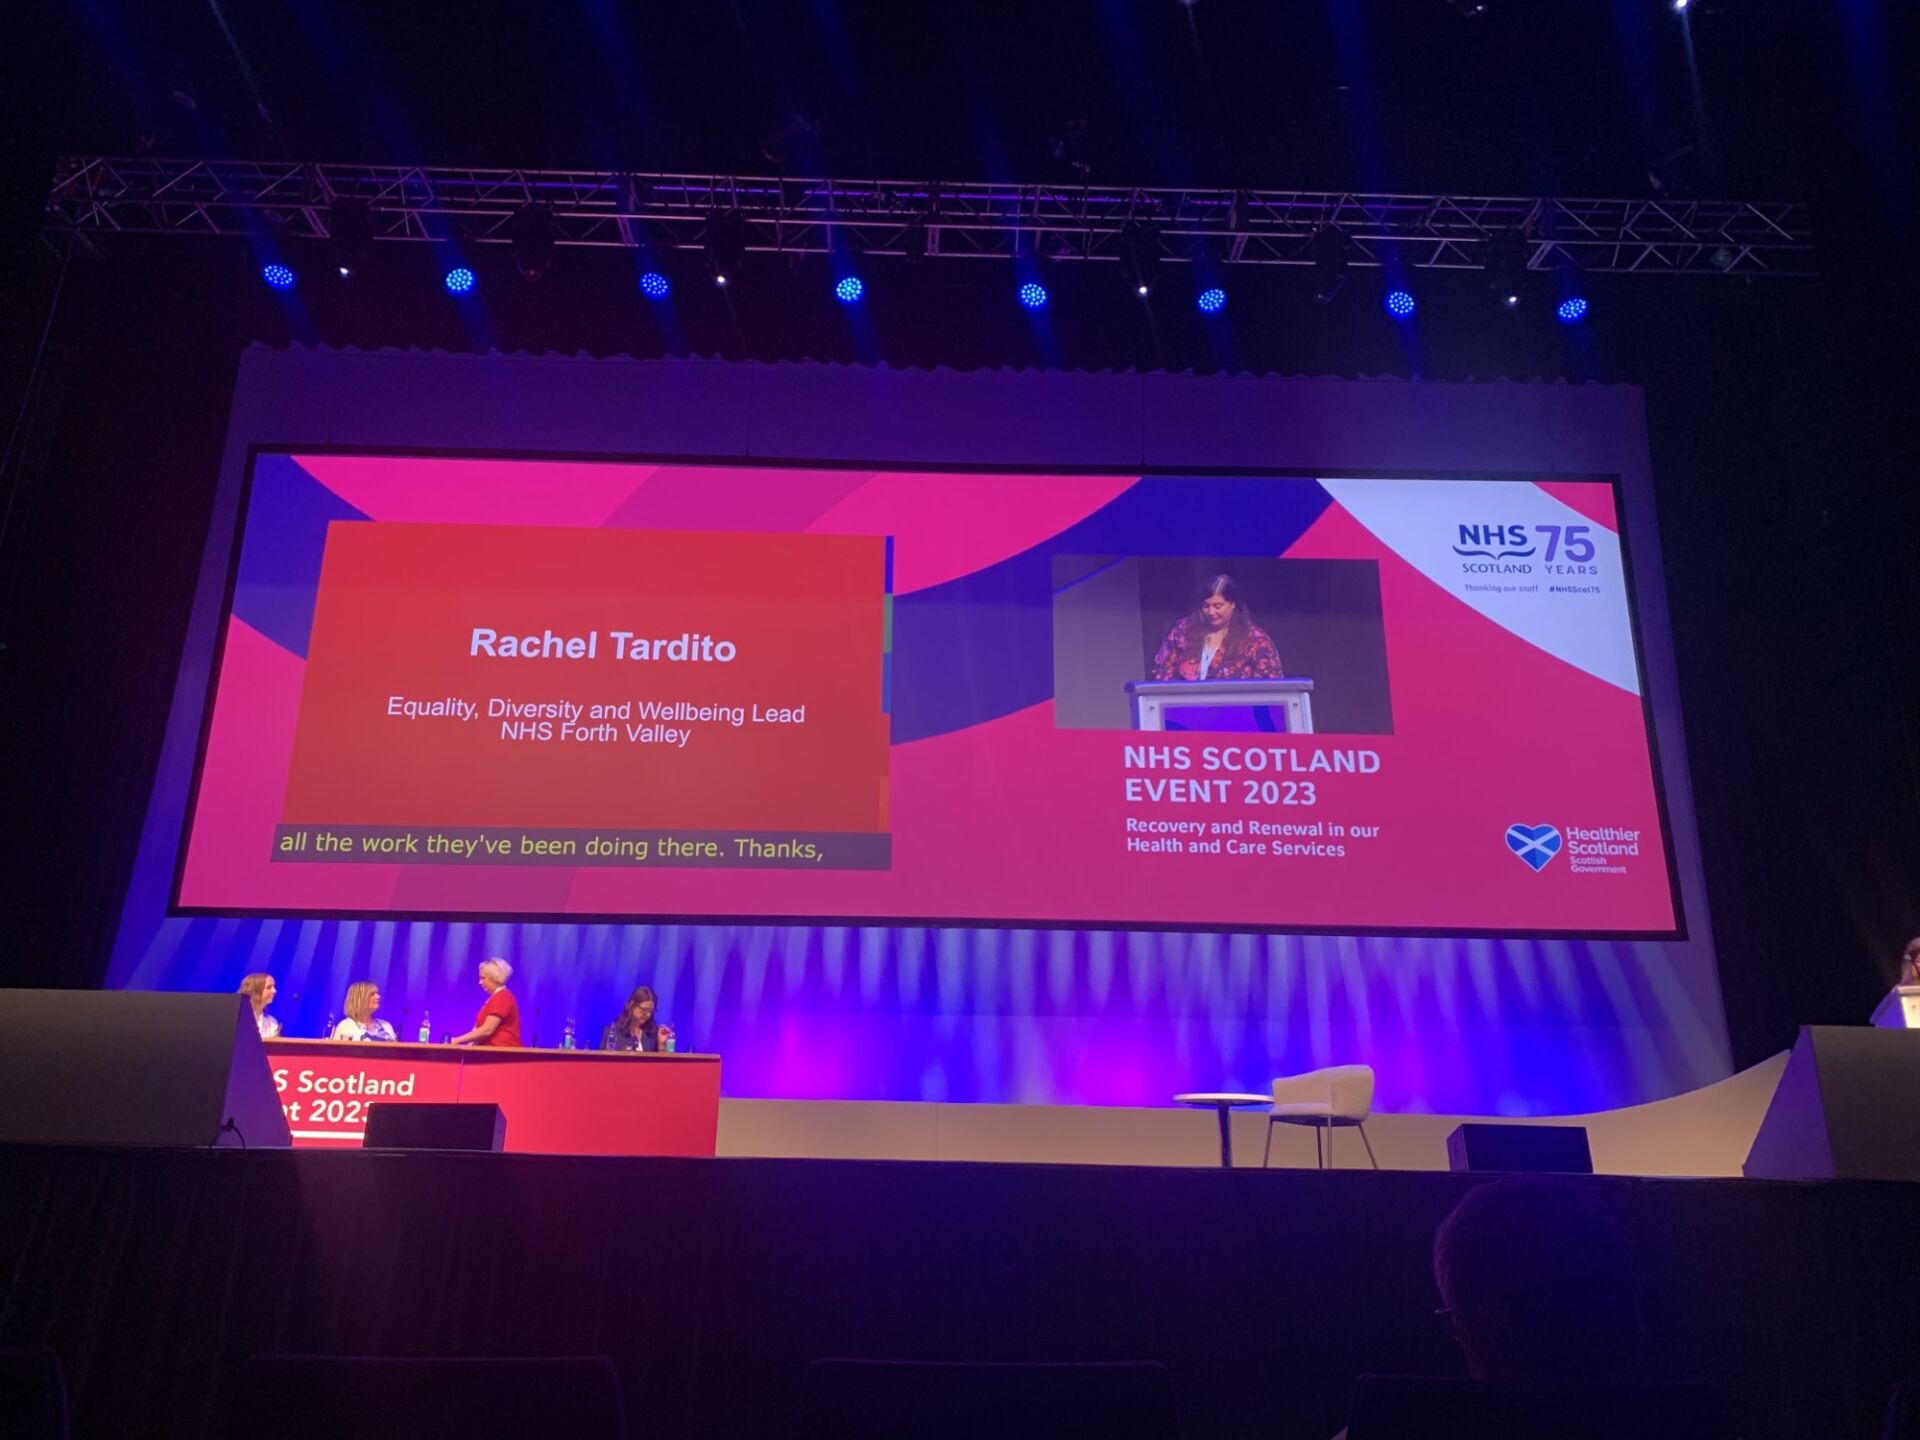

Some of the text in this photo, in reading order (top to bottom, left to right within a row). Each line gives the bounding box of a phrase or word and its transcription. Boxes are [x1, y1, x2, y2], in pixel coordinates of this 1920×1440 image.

[1458, 524, 1596, 563] NHS 75
[1462, 563, 1599, 575] SCOTLAND YEARS
[470, 628, 737, 662] Rachel Tardito
[387, 696, 806, 726] Equality, Diversity and Wellbeing Lead
[501, 721, 692, 748] NHS Forth Valley
[1124, 746, 1381, 774] NHS SCOTLAND
[1125, 778, 1317, 806] EVENT 2023
[1126, 818, 1380, 838] Recovery and Renewal in our
[1566, 827, 1640, 841] Healthier
[279, 832, 824, 862] all the work they've been doing there. Thanks,
[1127, 837, 1346, 857] Health and Care Services
[1568, 841, 1639, 856] Scotland
[1570, 856, 1607, 865] Scottish
[1571, 864, 1627, 874] Government
[297, 1070, 415, 1096] Scotland
